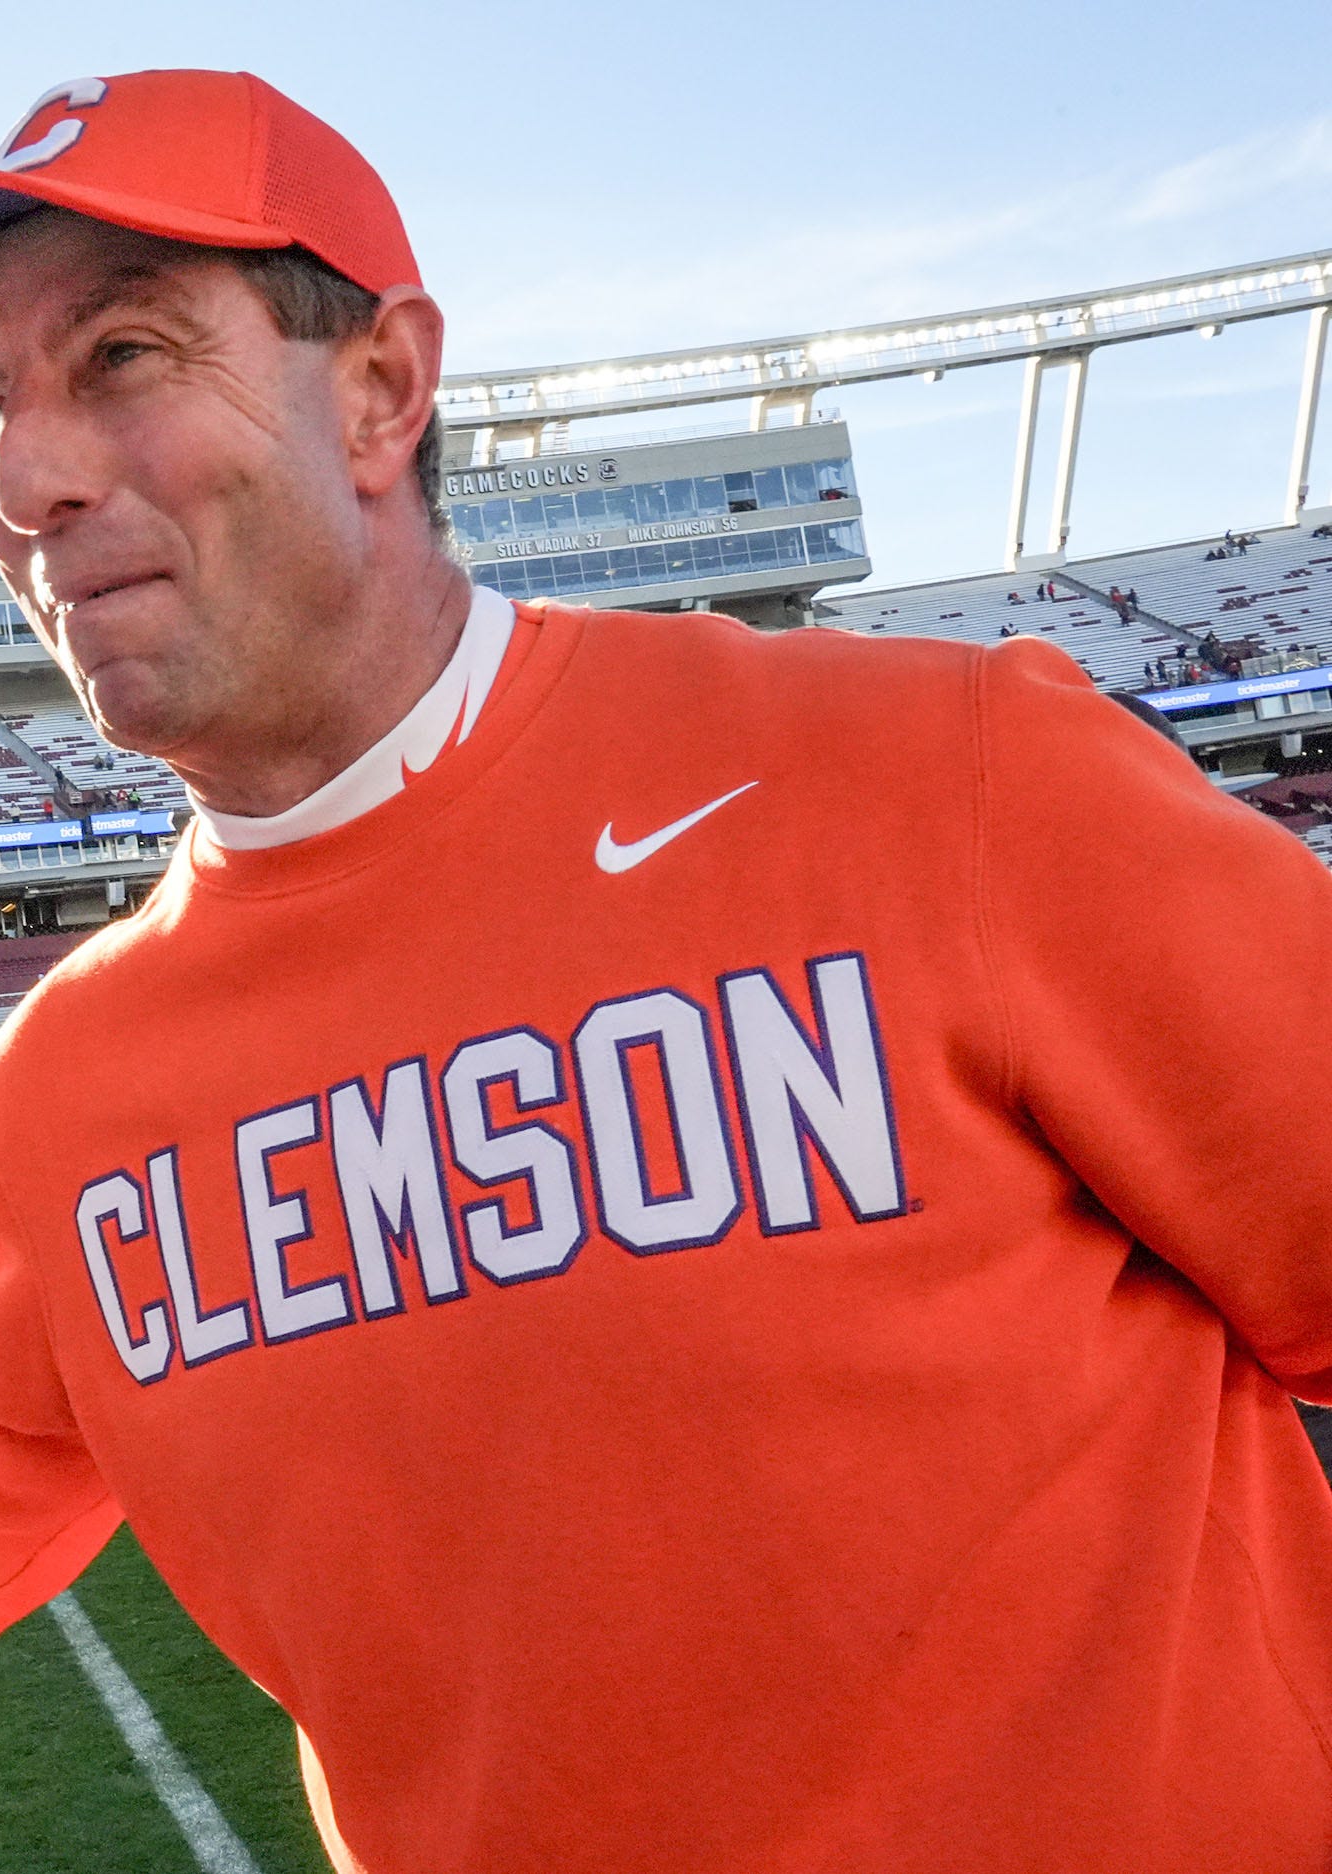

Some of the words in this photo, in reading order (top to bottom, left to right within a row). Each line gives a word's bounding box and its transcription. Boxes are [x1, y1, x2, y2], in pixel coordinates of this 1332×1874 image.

[446, 463, 589, 495] GAMECOCKS
[498, 541, 532, 558] STEVE
[536, 535, 580, 553] WADIAK
[587, 533, 602, 547] 37
[628, 528, 660, 543] MIKE
[661, 519, 716, 539] JOHNSON
[1237, 679, 1300, 695] ticketmaster
[76, 951, 907, 1387] CLEMSON
